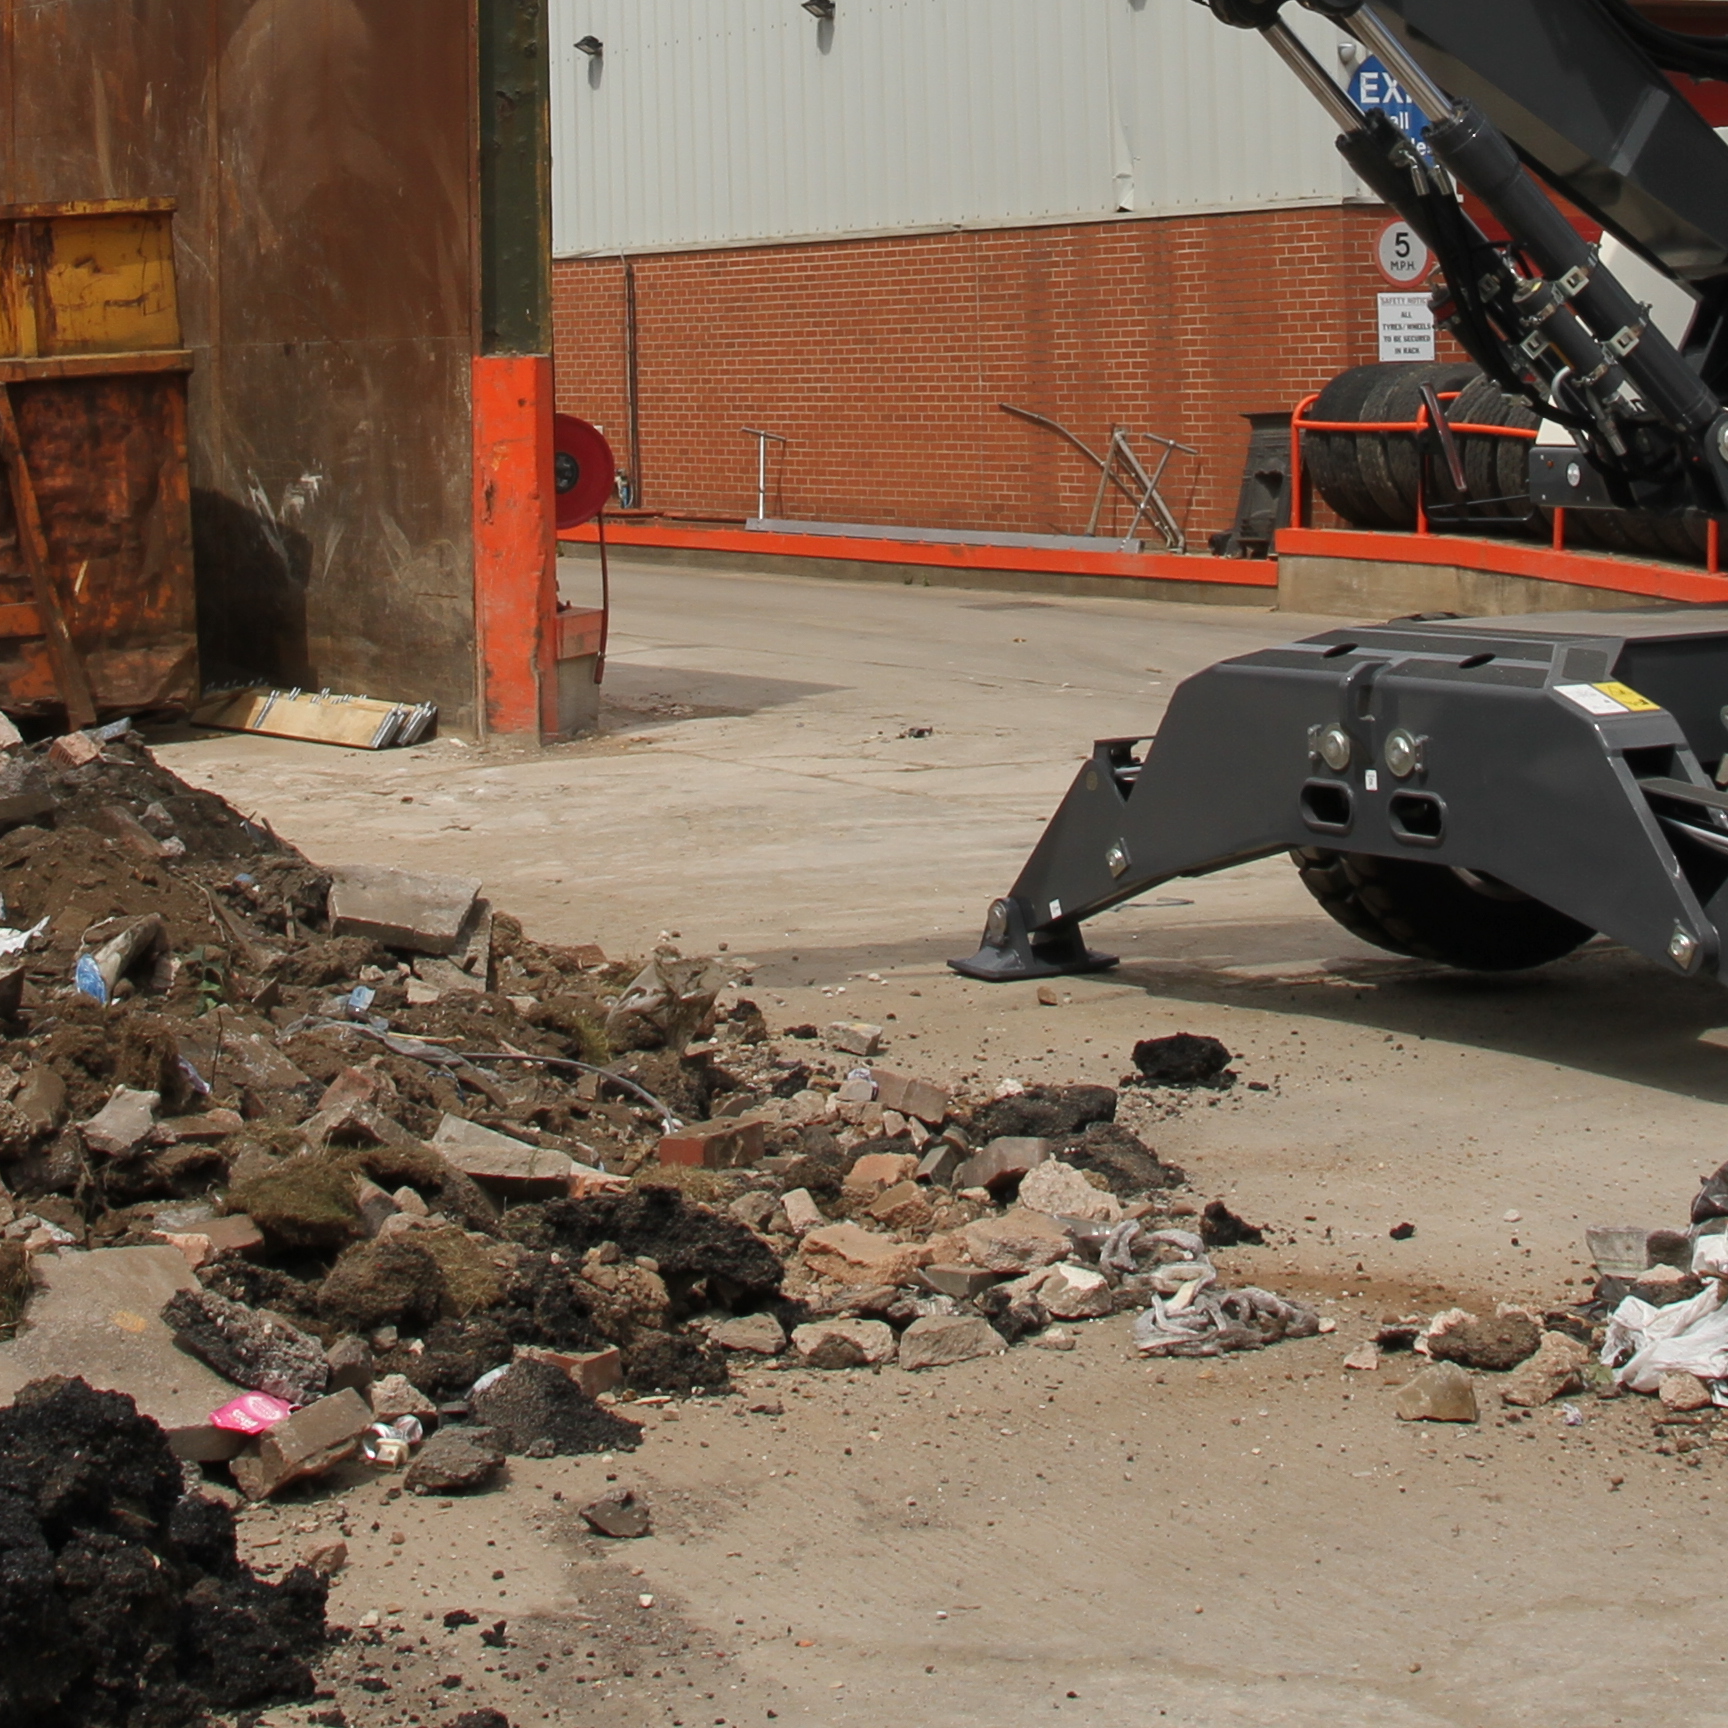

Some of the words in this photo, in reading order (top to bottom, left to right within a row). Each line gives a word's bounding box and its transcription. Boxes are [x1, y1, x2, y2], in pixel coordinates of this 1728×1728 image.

[1394, 232, 1410, 258] 5
[1380, 297, 1405, 305] SAFETY
[1383, 335, 1392, 343] TO
[1403, 334, 1431, 342] SECURED
